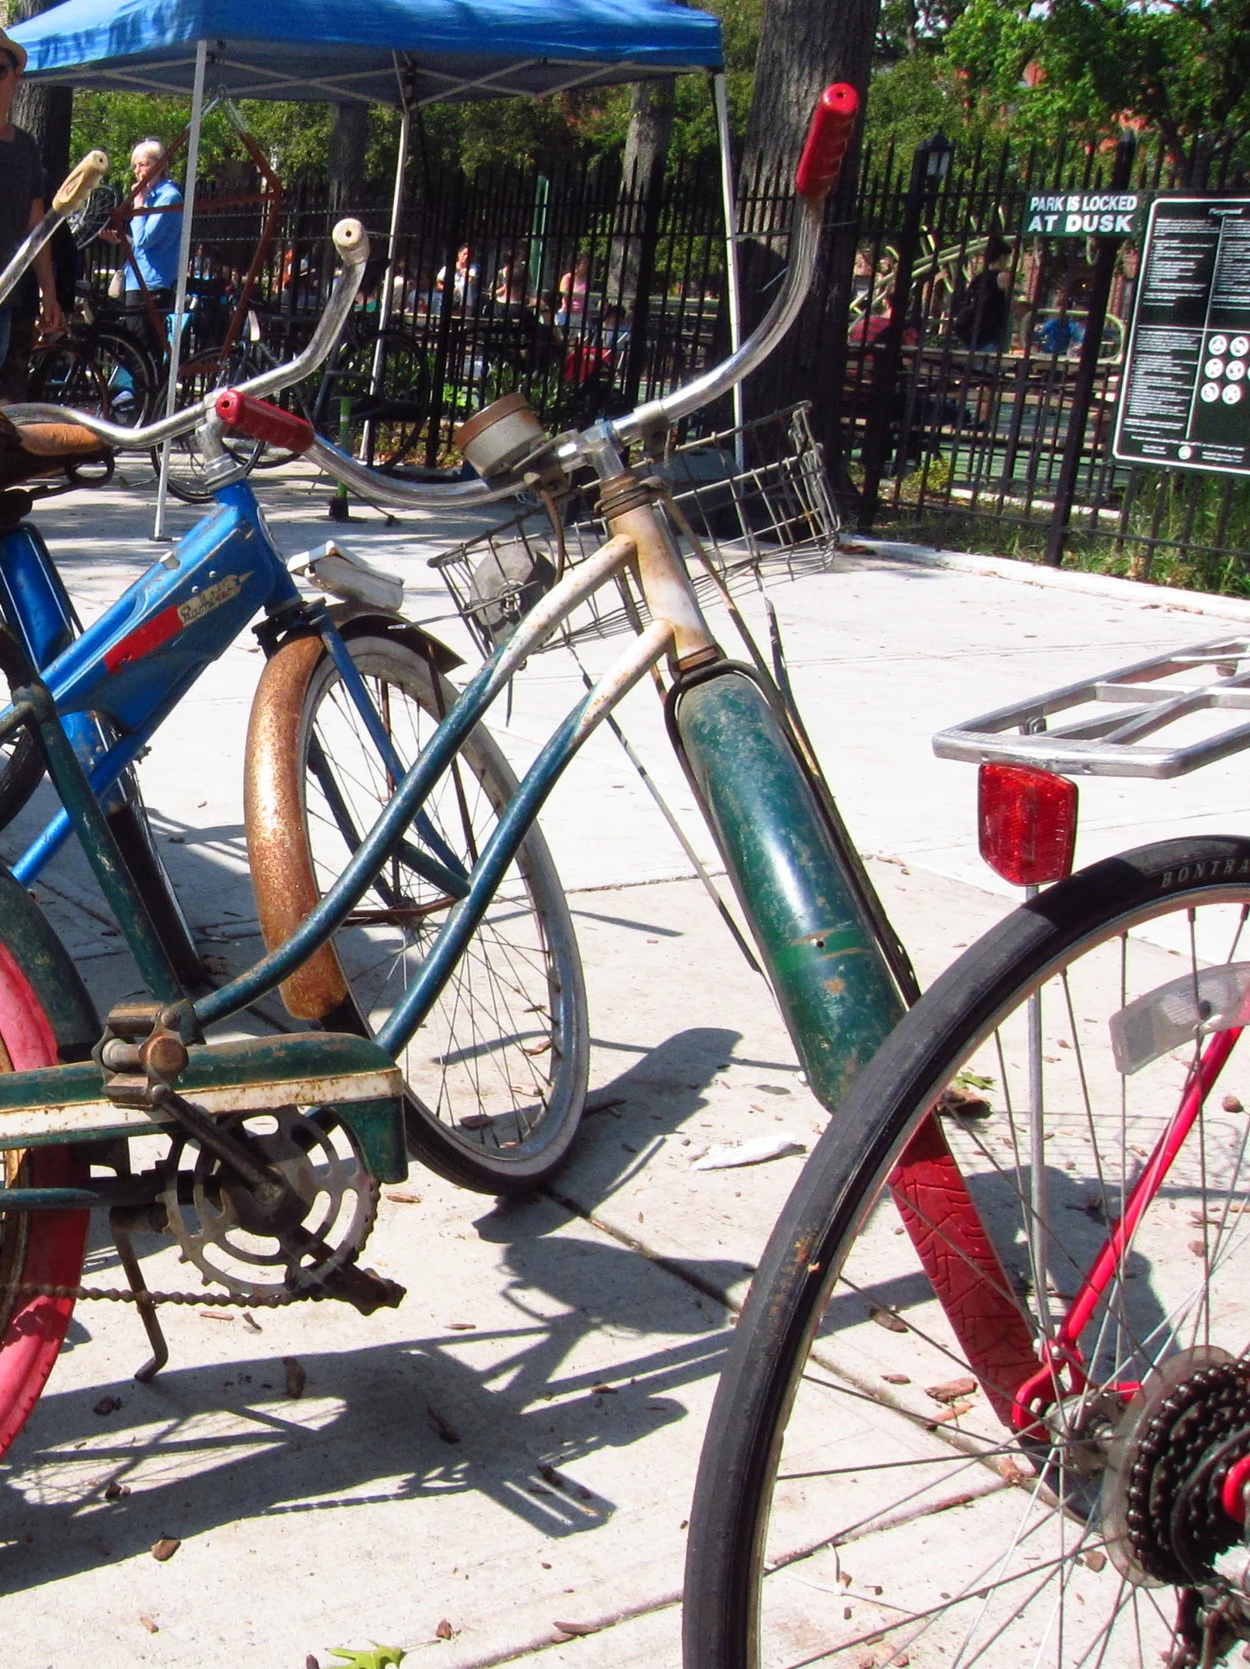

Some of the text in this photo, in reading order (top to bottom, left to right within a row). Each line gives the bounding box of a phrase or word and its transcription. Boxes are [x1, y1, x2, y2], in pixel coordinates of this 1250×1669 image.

[1029, 195, 1138, 212] PARK IS LOCKED
[1027, 214, 1059, 232] AT
[1064, 214, 1134, 233] DUSK
